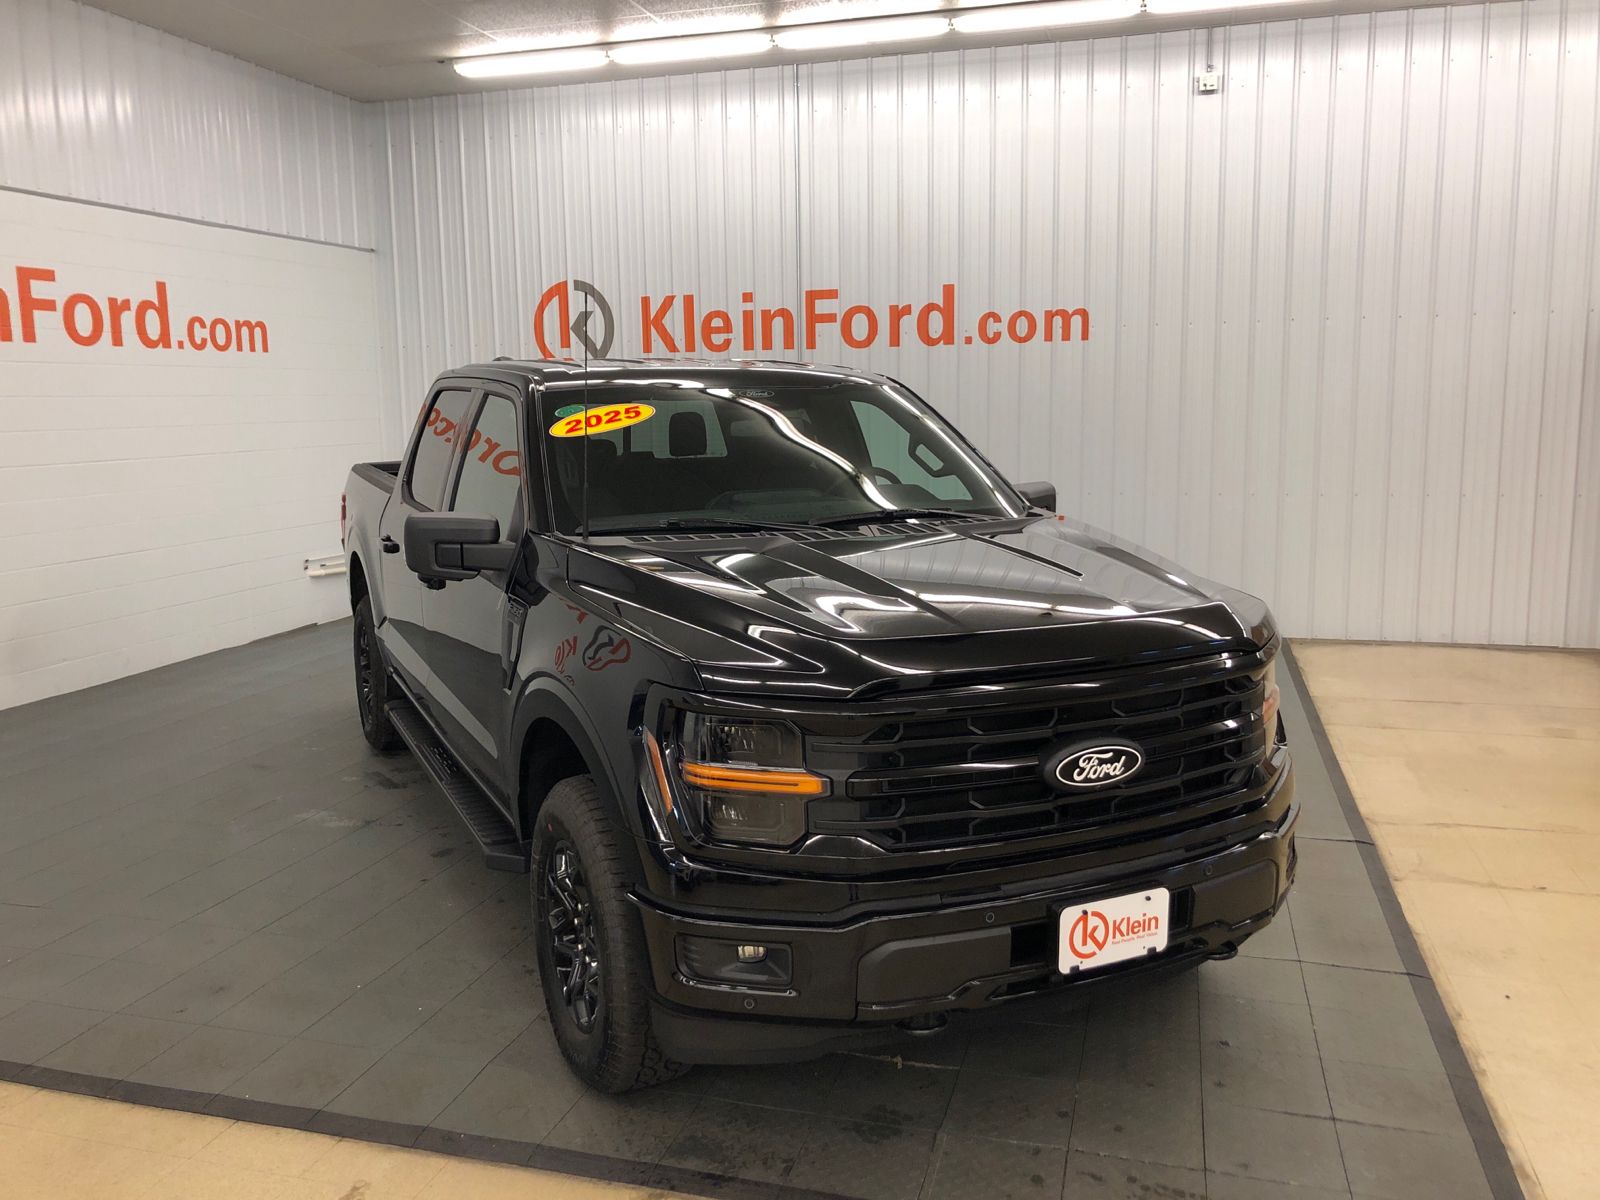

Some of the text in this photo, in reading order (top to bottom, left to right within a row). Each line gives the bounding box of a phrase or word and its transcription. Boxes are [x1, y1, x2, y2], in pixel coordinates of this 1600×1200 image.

[640, 284, 1090, 354] KleinFord.com
[564, 405, 641, 434] 2025
[1073, 752, 1126, 781] Ford
[1112, 912, 1159, 940] Klein
